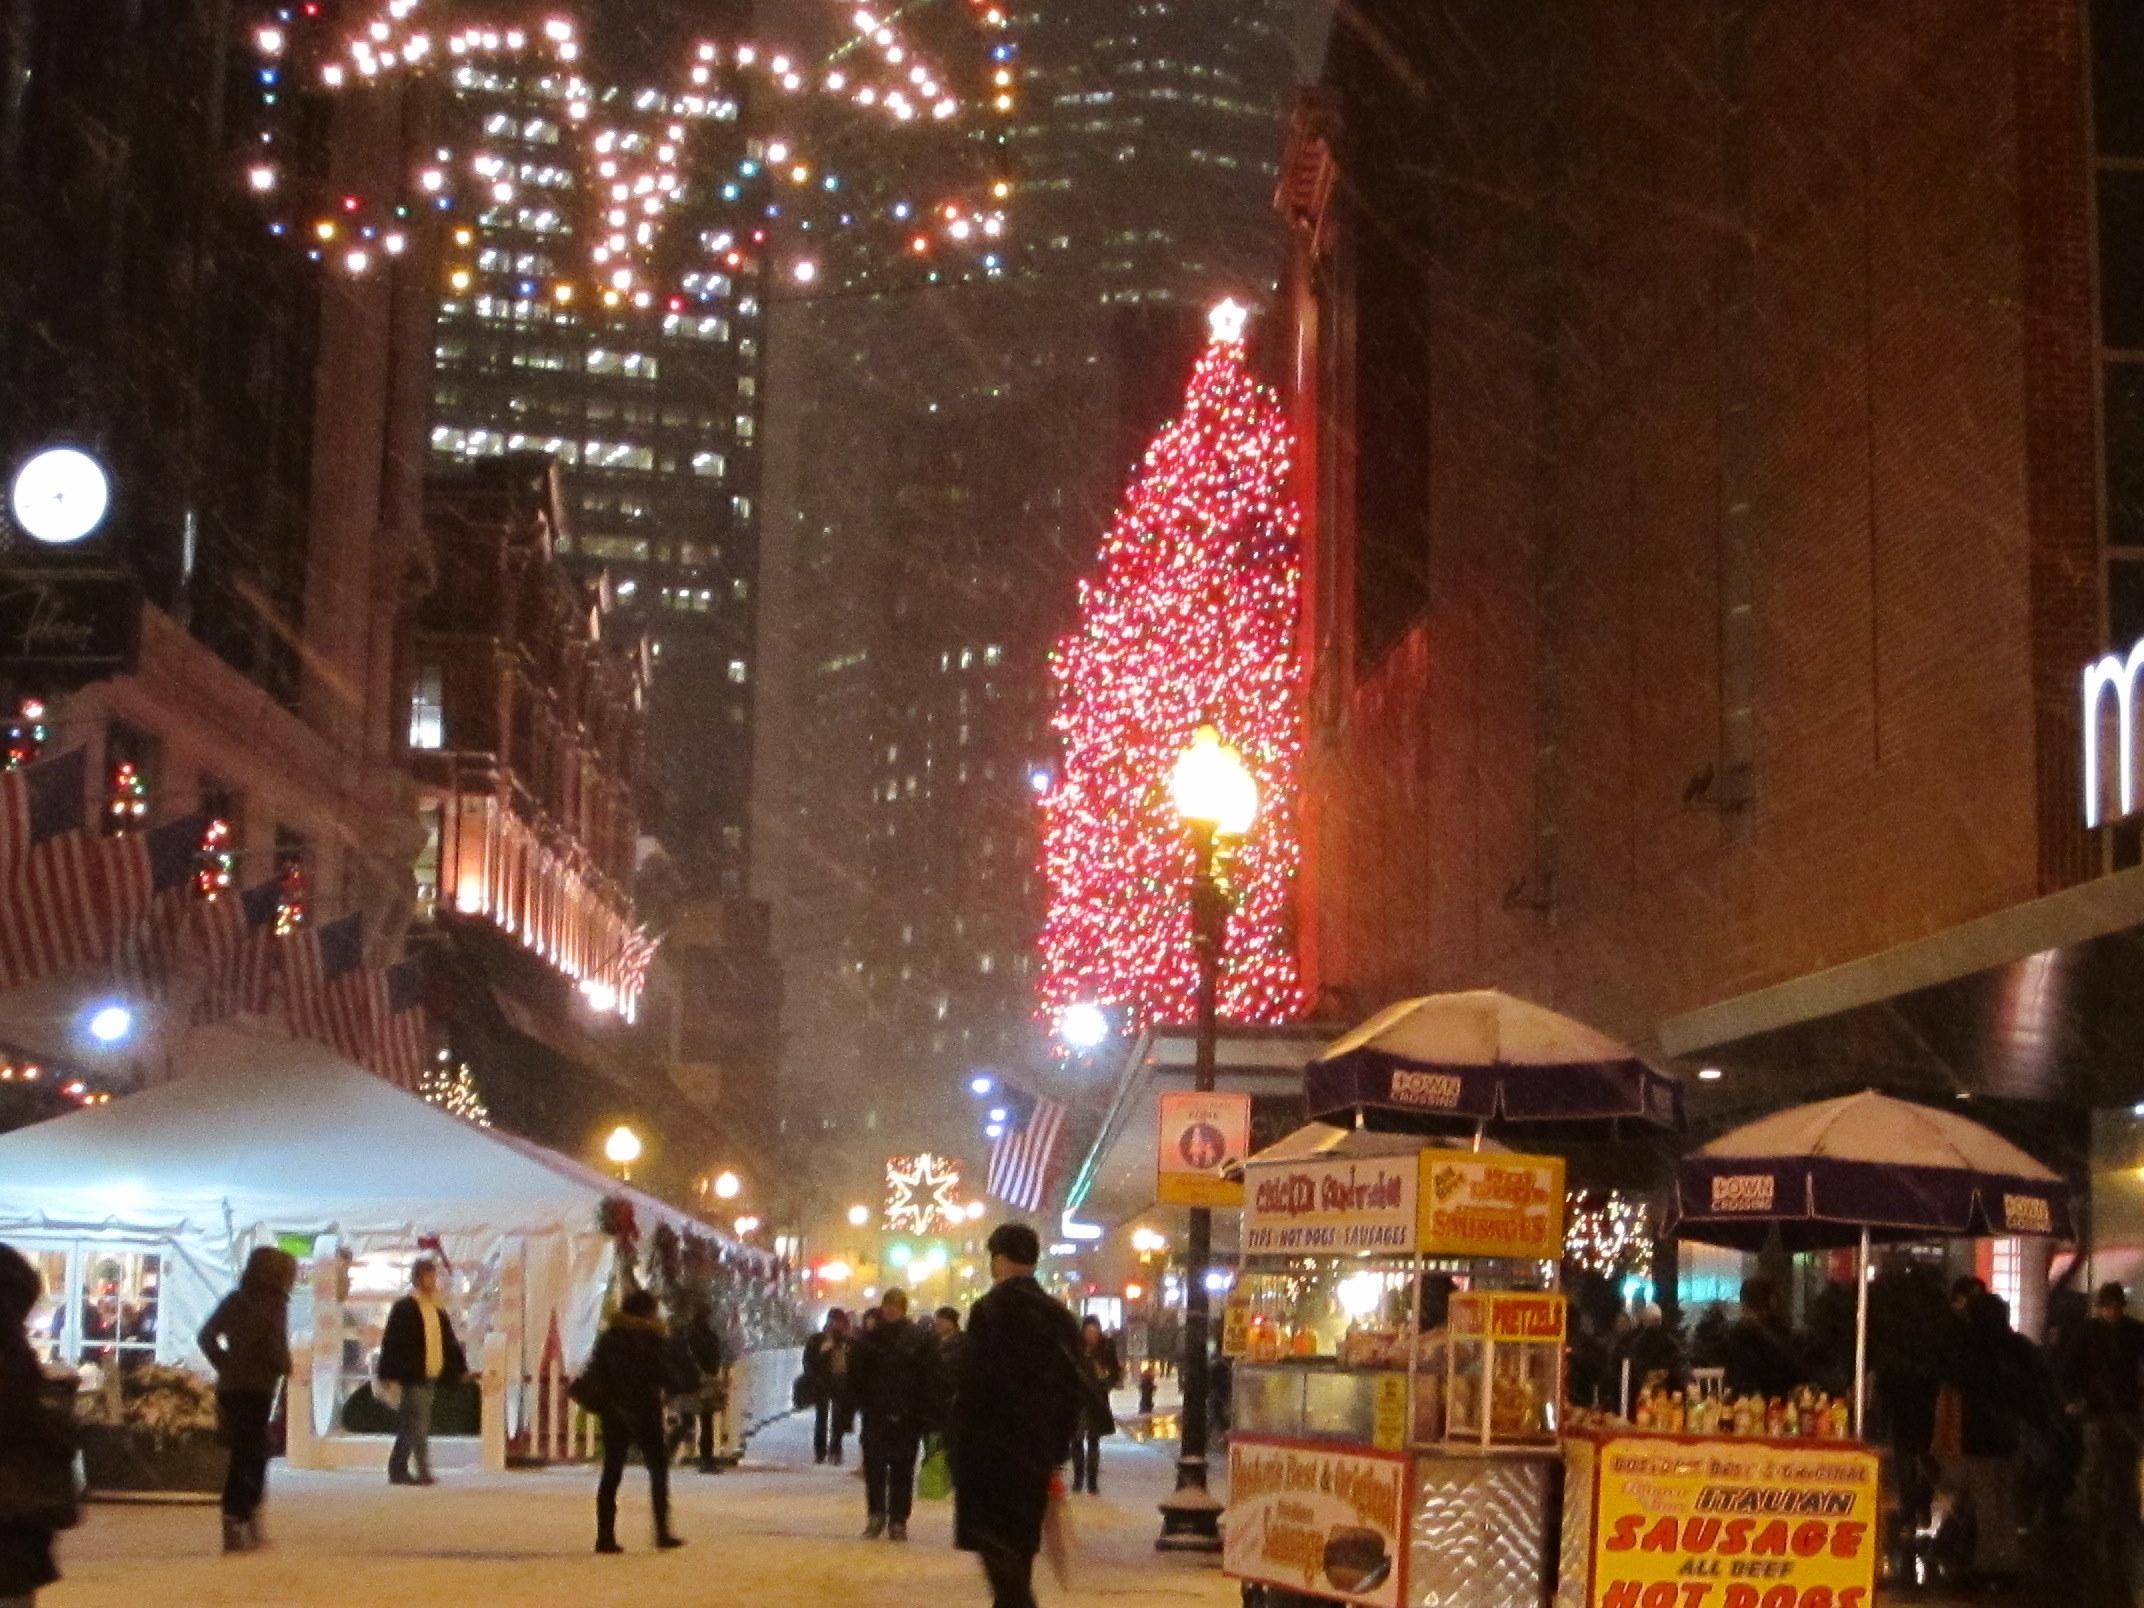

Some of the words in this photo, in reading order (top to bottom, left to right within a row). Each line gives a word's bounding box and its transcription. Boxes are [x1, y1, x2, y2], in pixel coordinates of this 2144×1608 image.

[1279, 1227, 1302, 1247] HOT
[1304, 1226, 1336, 1246] DOGS
[1345, 1224, 1407, 1246] SAUSAGES
[1695, 1486, 1856, 1516] ITALIAN
[1605, 1515, 1868, 1558] SAUSAGE
[1678, 1559, 1721, 1577] ALL
[1731, 1560, 1796, 1578] BEEF
[1602, 1580, 1712, 1608] HOT
[1724, 1582, 1867, 1608] DOGS
